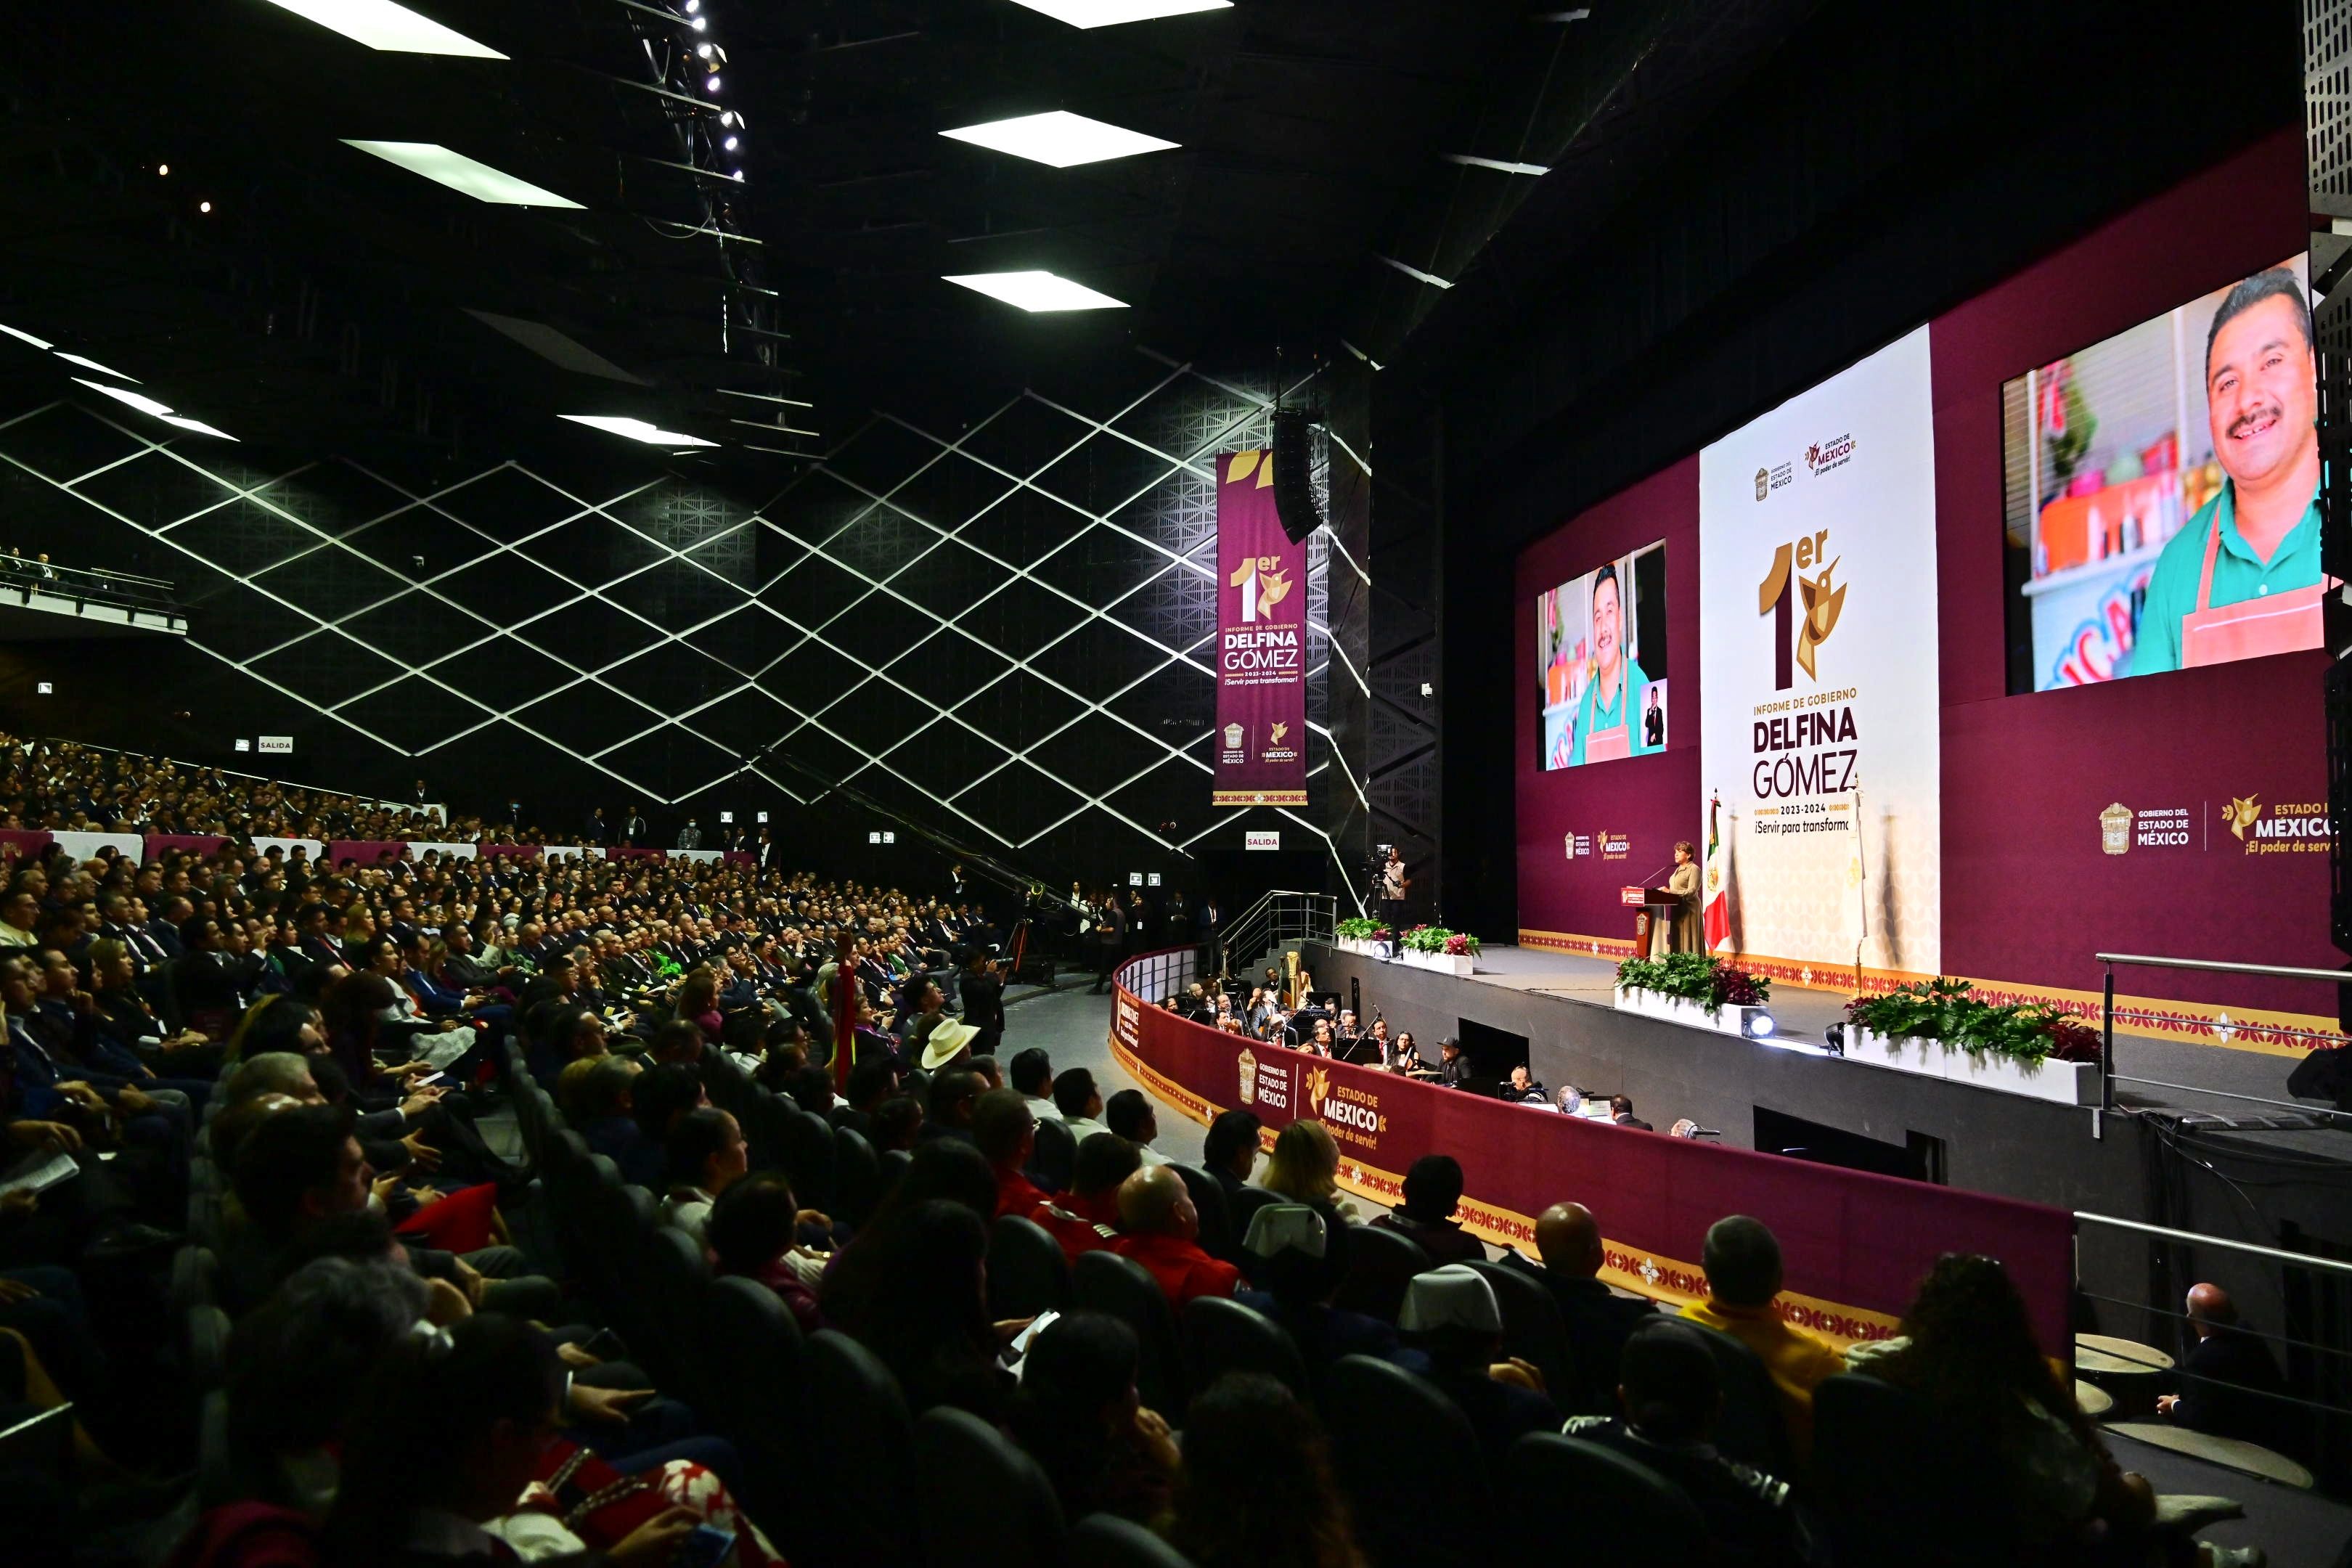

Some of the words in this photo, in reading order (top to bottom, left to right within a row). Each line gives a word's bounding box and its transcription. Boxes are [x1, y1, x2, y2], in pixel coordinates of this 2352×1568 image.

[1825, 436, 1843, 450] ESTADO
[1843, 433, 1850, 441] DE
[1771, 470, 1787, 481] ESTADO
[1820, 463, 1832, 476] poder
[1225, 632, 1298, 649] DELFINA
[1225, 649, 1298, 669] GÓMEZ
[1754, 700, 1790, 716] INFORME
[1793, 698, 1805, 709] DE
[1808, 687, 1857, 706] GOBIERNO
[1754, 707, 1858, 754] DELFINA
[1754, 749, 1858, 799] GÓMEZ
[1781, 803, 1826, 814] 2023-2024
[2275, 803, 2322, 814] ESTADO
[1782, 822, 1800, 836] para
[2139, 820, 2173, 830] ESTADO
[2176, 820, 2189, 828] DE
[2138, 830, 2189, 846] MÉXICO
[2245, 841, 2258, 855] ¡El
[2261, 840, 2290, 855] poder
[2292, 840, 2305, 852] de
[2308, 842, 2331, 852] serv
[1259, 1063, 1279, 1075] GOBIERNO
[1259, 1074, 1279, 1089] ESTADO
[1279, 1081, 1287, 1091] DE
[1259, 1087, 1286, 1108] MÉXICO
[1337, 1086, 1366, 1103] ESTADO
[1367, 1094, 1378, 1108] DE
[1324, 1098, 1377, 1132] MÉXICO
[1346, 1127, 1354, 1142] de
[1355, 1134, 1376, 1150] servir!
